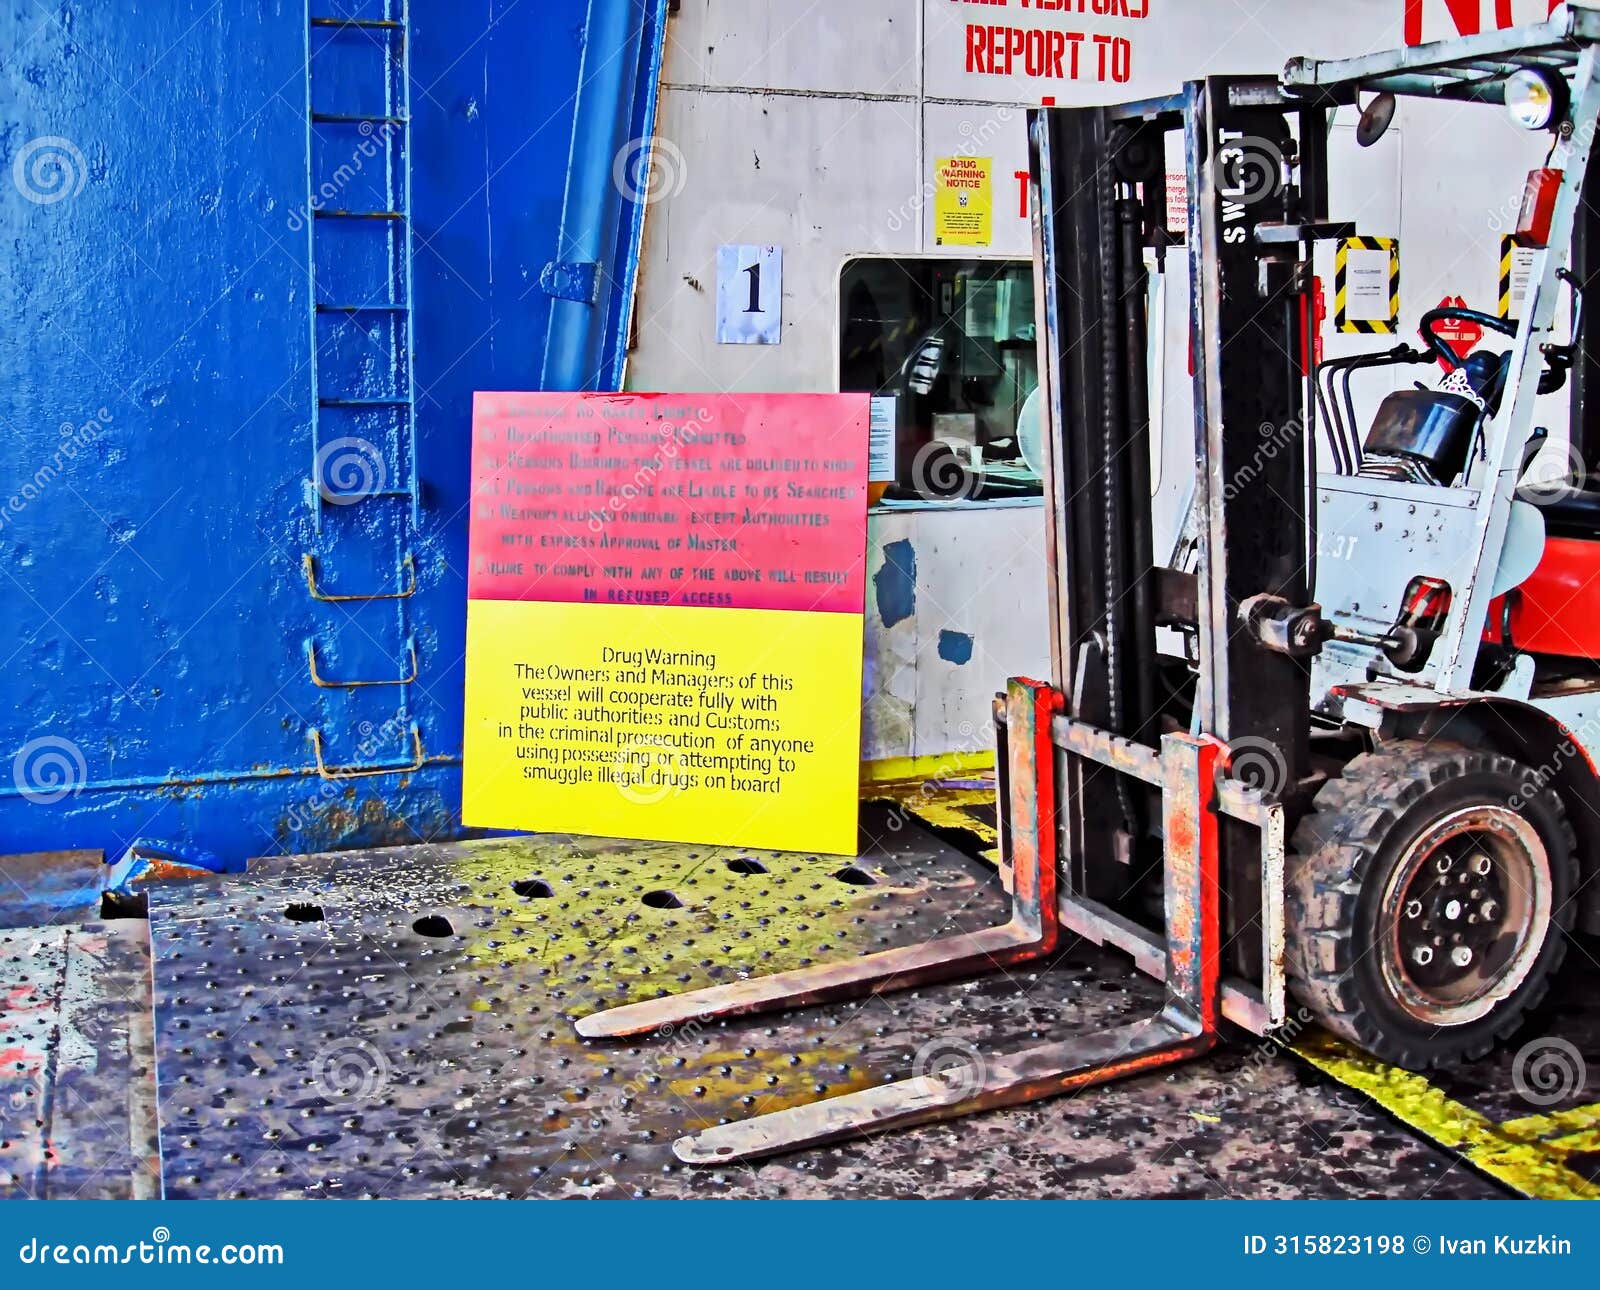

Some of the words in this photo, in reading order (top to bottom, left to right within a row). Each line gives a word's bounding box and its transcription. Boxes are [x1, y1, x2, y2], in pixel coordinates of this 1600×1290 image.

[966, 24, 1084, 79] REPORT
[1093, 34, 1131, 83] TO
[942, 169, 985, 179] WARNING
[951, 160, 976, 168] DRUG
[946, 179, 980, 189] NOTICE
[742, 262, 765, 313] 1
[603, 647, 642, 667] Drug
[645, 649, 715, 670] Warning
[514, 664, 544, 679] The
[548, 665, 609, 681] Owners
[616, 668, 645, 683] and
[652, 669, 733, 690] Managers
[739, 673, 756, 688] of
[763, 674, 792, 690] this
[522, 686, 570, 701] vessel
[578, 687, 603, 702] will
[610, 691, 692, 710] cooperate
[699, 691, 734, 713] fully
[742, 695, 776, 711] with
[520, 702, 568, 722] public
[574, 706, 662, 725] authorities
[669, 712, 699, 727] and
[706, 713, 779, 731] Customs
[499, 722, 511, 737] in
[519, 723, 544, 739] the
[550, 726, 612, 743] criminal
[617, 729, 714, 750] prosecution
[727, 734, 744, 750] of
[751, 737, 814, 756] anyone
[517, 745, 558, 763] using
[563, 749, 649, 769] possessing
[658, 753, 673, 764] or
[680, 752, 770, 775] attempting
[778, 756, 795, 772] to
[524, 765, 592, 784] smuggle
[597, 767, 644, 787] illegal
[651, 769, 698, 790] drugs
[705, 776, 725, 788] on
[732, 773, 779, 792] board
